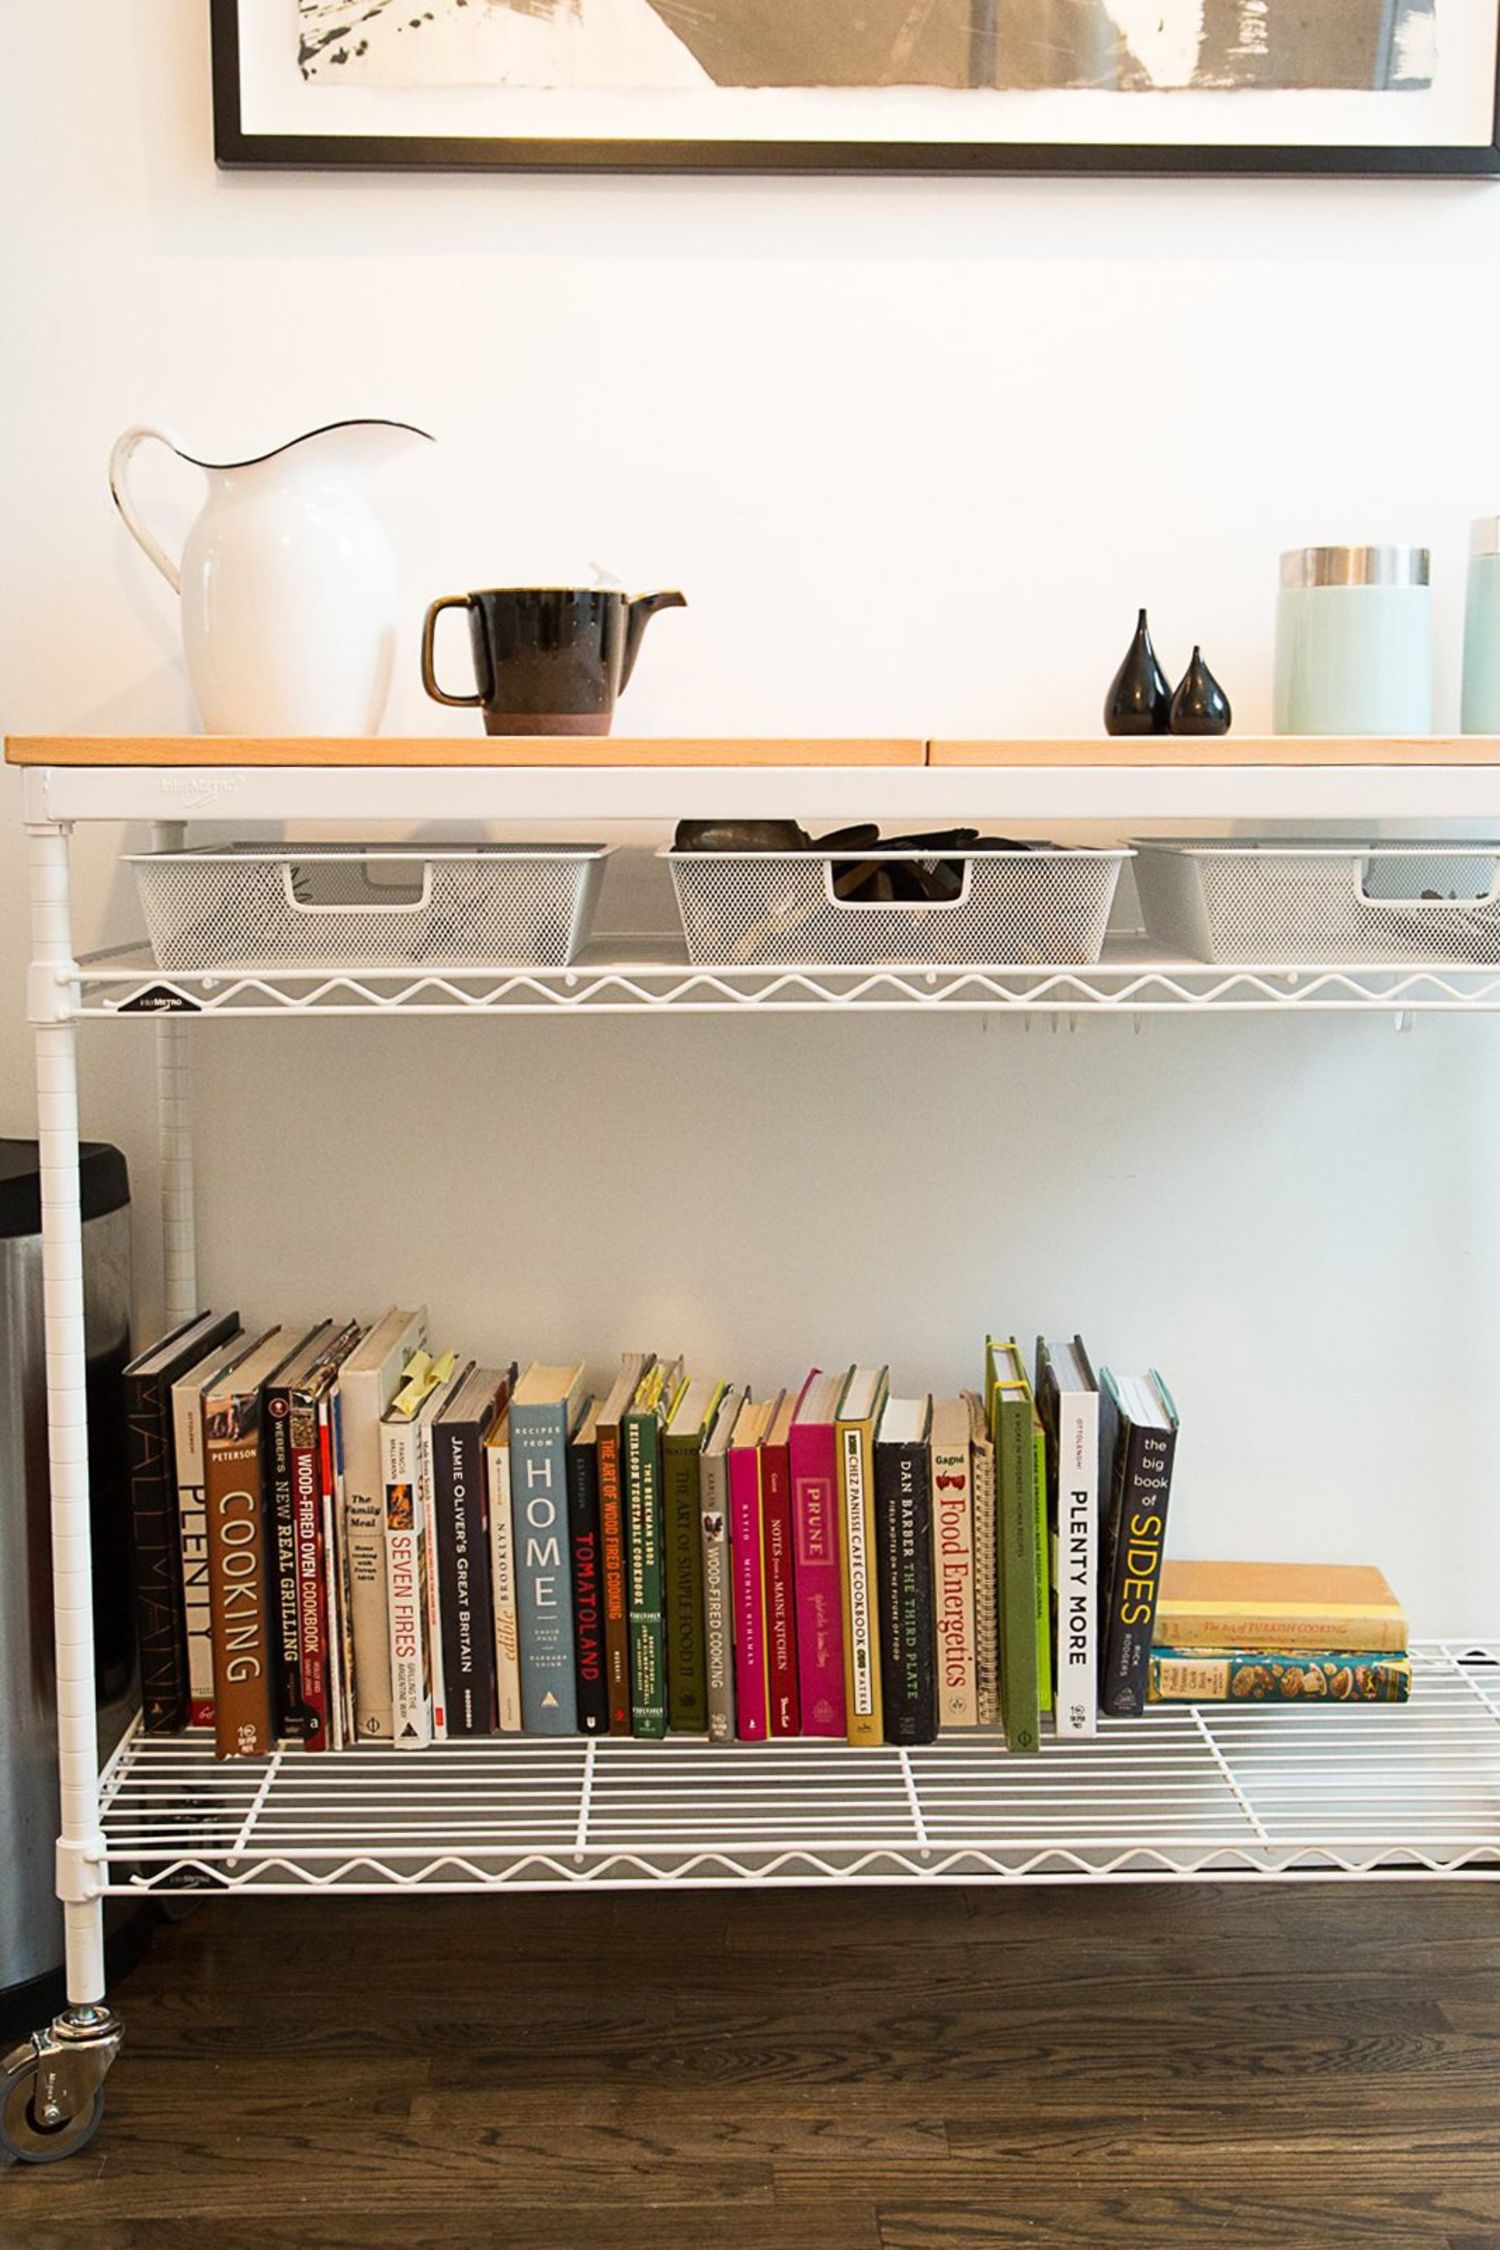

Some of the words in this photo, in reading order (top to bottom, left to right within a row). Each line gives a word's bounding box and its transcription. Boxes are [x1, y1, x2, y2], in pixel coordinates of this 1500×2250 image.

[274, 1421, 288, 1473] WEBER'S
[515, 1427, 561, 1435] RECIPES
[523, 1439, 553, 1448] FROM
[602, 1440, 614, 1460] THE
[629, 1423, 640, 1479] HEIRLOOM
[1144, 1439, 1167, 1451] the
[211, 1449, 257, 1462] PETERSON
[389, 1439, 398, 1480] MALLMANN
[398, 1442, 406, 1474] FRANCIS
[451, 1436, 464, 1480] JAMIE
[602, 1462, 615, 1482] ART
[644, 1463, 653, 1483] THE
[849, 1456, 860, 1485] CHEZ
[901, 1460, 912, 1492] DAN
[935, 1454, 965, 1466] Gagné
[1142, 1457, 1164, 1472] big
[275, 1480, 291, 1520] NEW
[298, 1454, 316, 1537] WOOD-FIRED
[351, 1494, 372, 1504] The
[603, 1485, 616, 1499] OF
[676, 1471, 689, 1495] THE
[1134, 1475, 1168, 1489] book
[1141, 1495, 1157, 1507] of
[344, 1506, 381, 1516] Family
[351, 1518, 376, 1527] Meal
[453, 1485, 469, 1553] OLIVER'S
[526, 1458, 561, 1607] HOME
[604, 1503, 618, 1535] WOOD
[631, 1483, 642, 1544] VEGETABLE
[645, 1487, 654, 1537] BEEKMAN
[677, 1499, 690, 1529] ART
[807, 1487, 823, 1556] PRUNE
[850, 1488, 861, 1533] PANISSE
[901, 1499, 914, 1557] BARBER
[940, 1498, 970, 1556] Food
[278, 1525, 294, 1572] REAL
[301, 1542, 317, 1577] OVEN
[606, 1537, 620, 1570] FIRED
[771, 1519, 783, 1556] NOTES
[851, 1536, 865, 1567] CAFÉ
[1070, 1490, 1088, 1585] PLENTY
[391, 1536, 413, 1598] SEVEN
[457, 1558, 470, 1606] GREAT
[497, 1523, 510, 1602] BROOKLYN
[632, 1547, 643, 1605] COOKBOOK
[678, 1556, 692, 1612] SIMPLE
[744, 1558, 753, 1607] MICHAEL
[890, 1556, 896, 1568] ON
[904, 1562, 915, 1593] THE
[1120, 1513, 1162, 1626] SIDES
[219, 1491, 261, 1683] COOKING
[575, 1532, 600, 1681] TOMATOLAND
[607, 1572, 622, 1620] COOKING
[708, 1546, 721, 1628] WOOD-FIRED
[774, 1581, 785, 1619] MAINE
[853, 1571, 867, 1647] COOKBOOK
[891, 1589, 899, 1621] FUTURE
[280, 1578, 298, 1661] GRILLING
[303, 1581, 319, 1653] COOKBOOK
[394, 1605, 416, 1658] FIRES
[497, 1609, 515, 1661] edible
[679, 1615, 694, 1658] FOOD
[892, 1623, 899, 1635] OF
[905, 1600, 916, 1647] THIRD
[936, 1562, 973, 1688] Energetics
[1070, 1596, 1087, 1665] MORE
[1204, 1621, 1220, 1632] The
[1247, 1622, 1297, 1633] TURKISH
[1298, 1623, 1347, 1634] COOKING
[459, 1611, 472, 1673] BRITAIN
[710, 1631, 724, 1689] COOKING
[746, 1613, 754, 1666] RUHLMAN
[774, 1620, 787, 1671] KITCHEN
[892, 1637, 900, 1662] FOOD
[1119, 1633, 1132, 1677] RODGERS
[1132, 1645, 1141, 1667] RICK
[858, 1671, 868, 1712] WATERS
[906, 1653, 918, 1700] PLATE
[408, 1696, 416, 1709] THE
